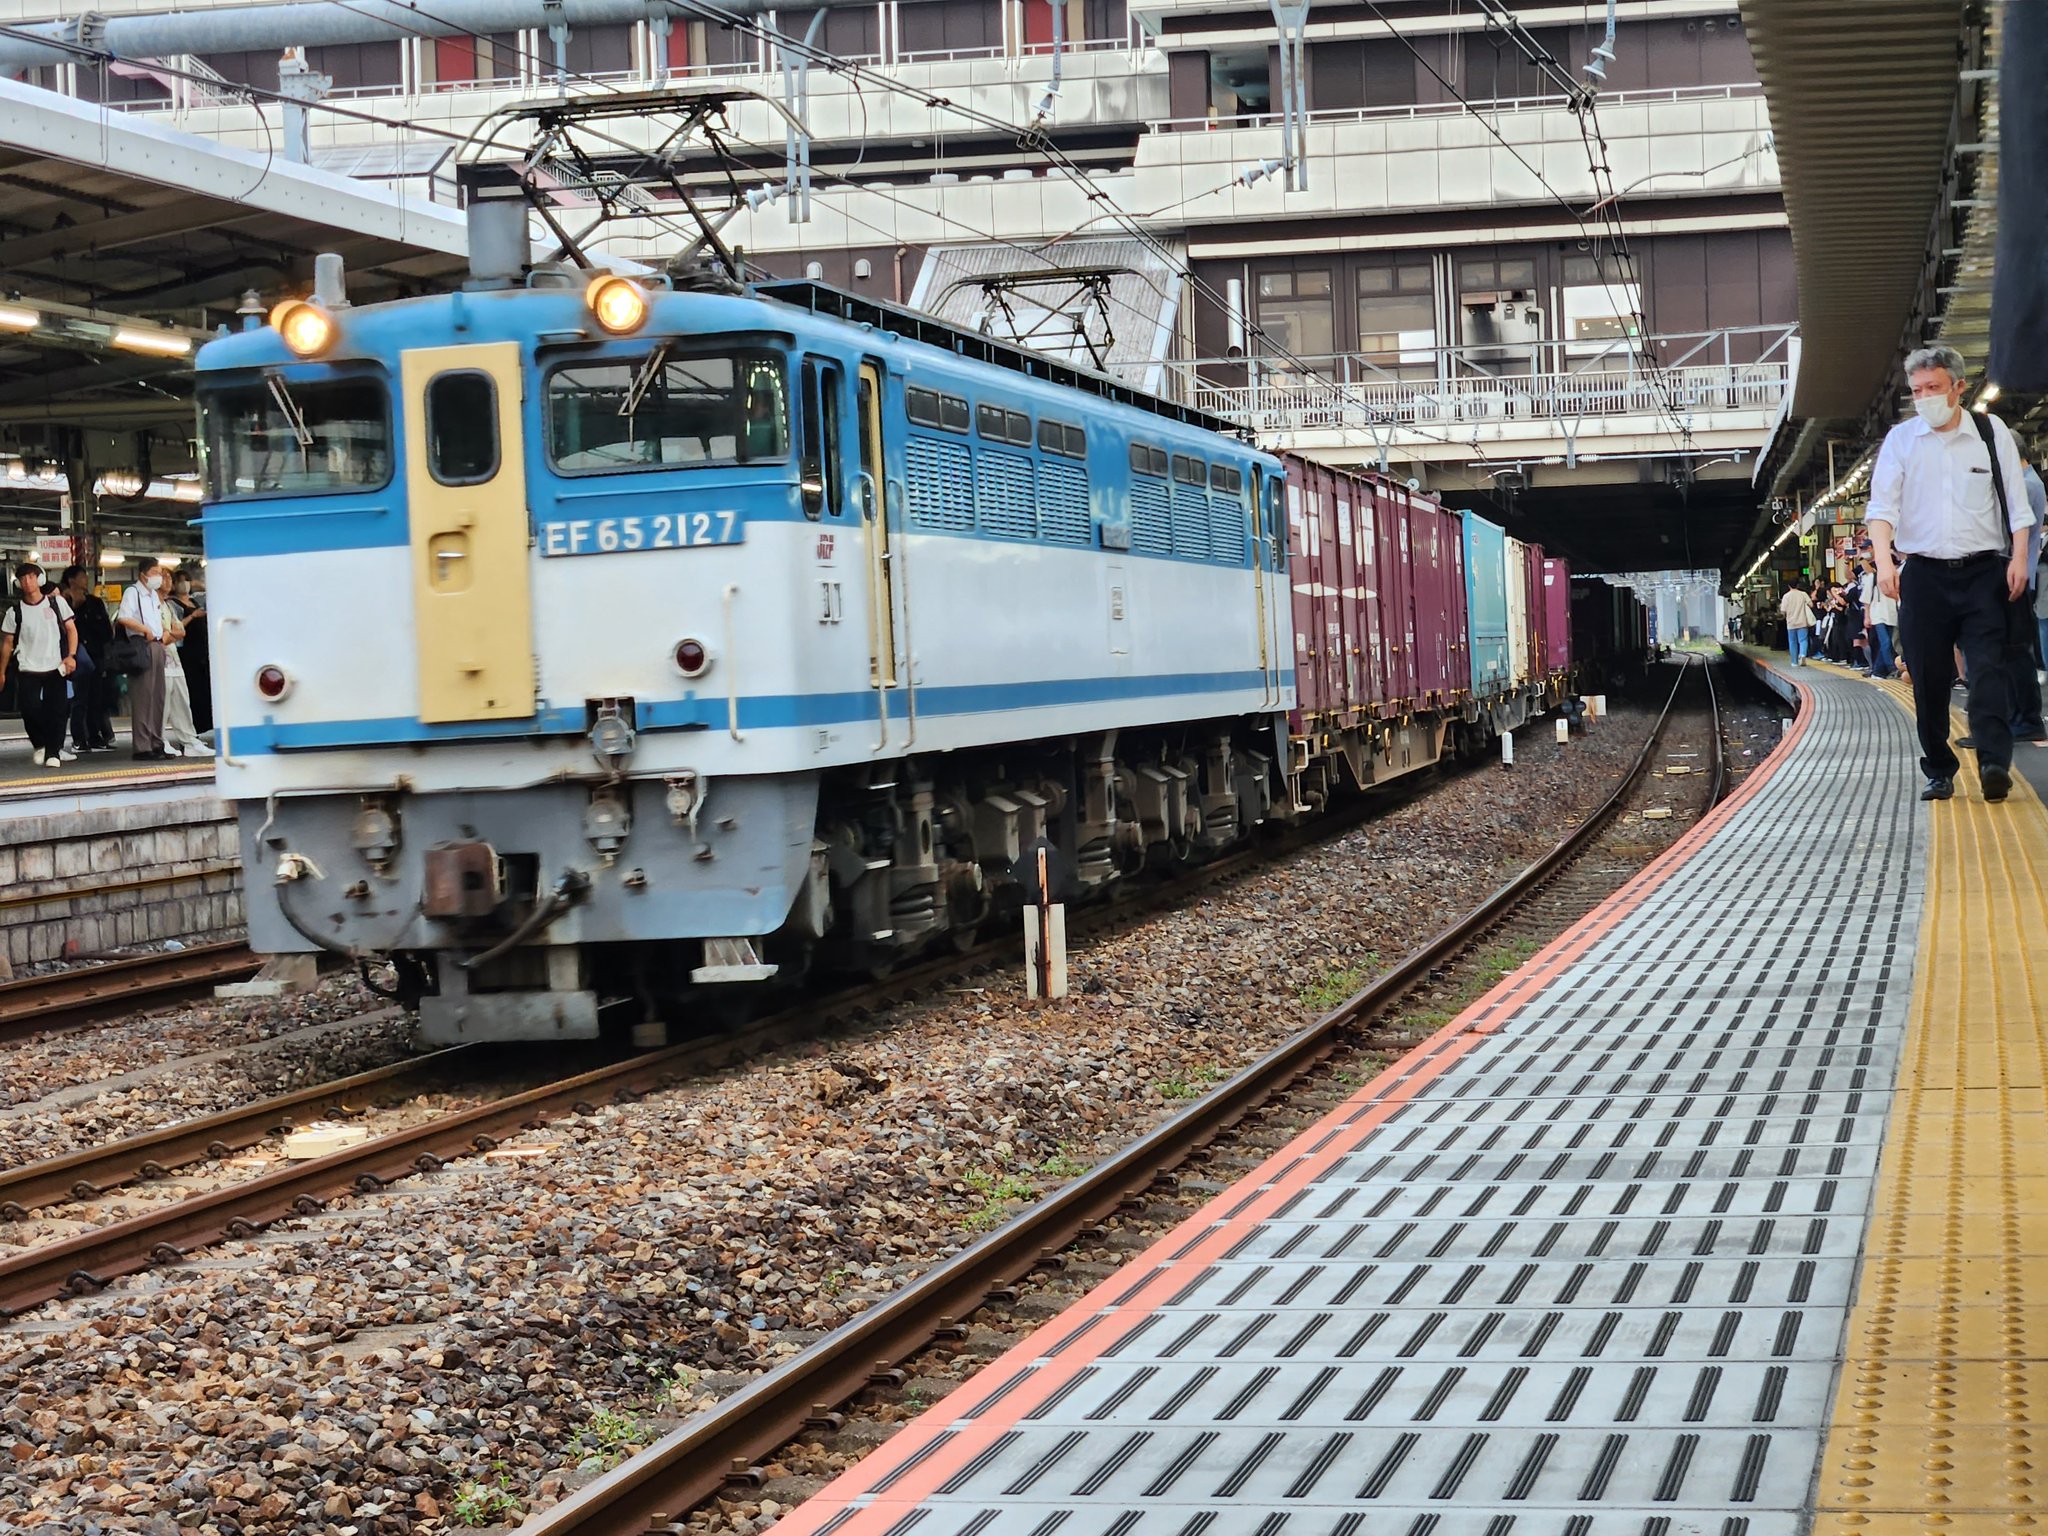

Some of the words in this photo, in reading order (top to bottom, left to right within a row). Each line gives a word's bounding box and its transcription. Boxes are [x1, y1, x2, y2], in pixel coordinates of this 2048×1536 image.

[546, 520, 591, 554] EF
[599, 517, 643, 550] 65
[653, 512, 736, 547] 2127
